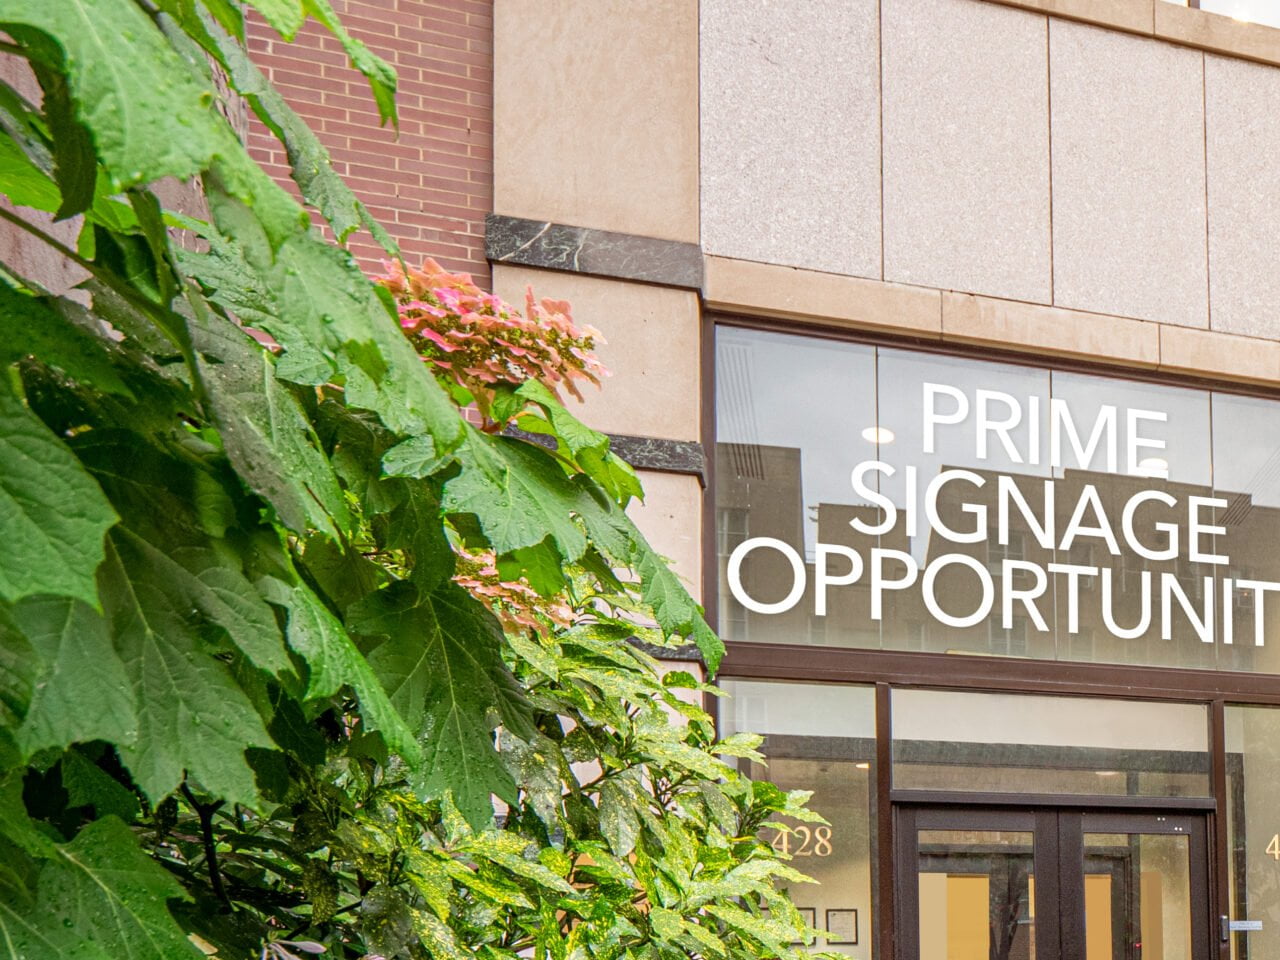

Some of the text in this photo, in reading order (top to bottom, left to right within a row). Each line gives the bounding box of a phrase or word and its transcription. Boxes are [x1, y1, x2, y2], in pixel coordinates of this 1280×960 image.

[922, 381, 1169, 479] PRIME
[849, 459, 1230, 565] SIGNAGE
[772, 825, 832, 856] 428
